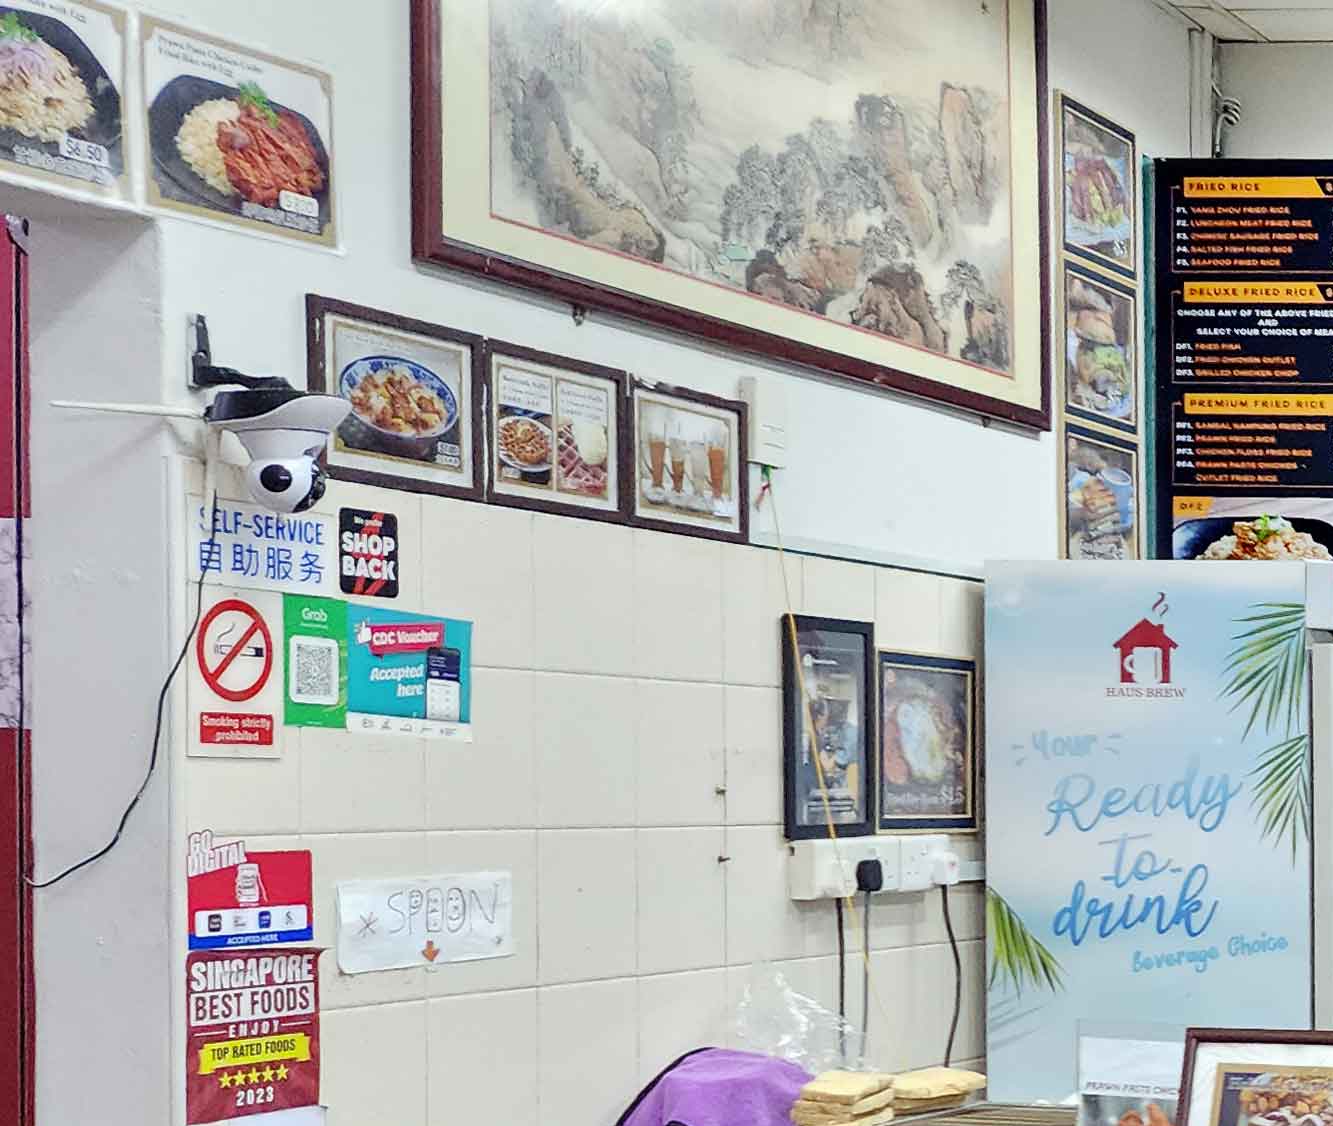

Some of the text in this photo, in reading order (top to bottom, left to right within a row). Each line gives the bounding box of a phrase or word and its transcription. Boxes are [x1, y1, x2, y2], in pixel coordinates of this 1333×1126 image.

[1187, 181, 1261, 193] FRIED RICE
[1189, 286, 1317, 298] DELUXE FRIED RICE
[1189, 399, 1326, 410] PREMIUM FRIED RICE
[341, 531, 395, 558] SHOP
[199, 537, 326, 585] 自助服务
[341, 555, 397, 582] BACK
[301, 607, 328, 622] Grab
[369, 664, 425, 682] Accepted
[396, 683, 424, 698] here
[1146, 686, 1188, 698] BREW
[1045, 757, 1244, 837] Ready
[388, 884, 499, 935] SPOON
[1052, 864, 1219, 946] drink
[1227, 933, 1289, 958] Choice
[191, 955, 315, 992] SINGAPORE
[194, 987, 311, 1022] BEST FOODS
[228, 1021, 281, 1039] ENJOY
[211, 1039, 297, 1061] TOP RATED FOODS
[235, 1086, 275, 1107] 2023
